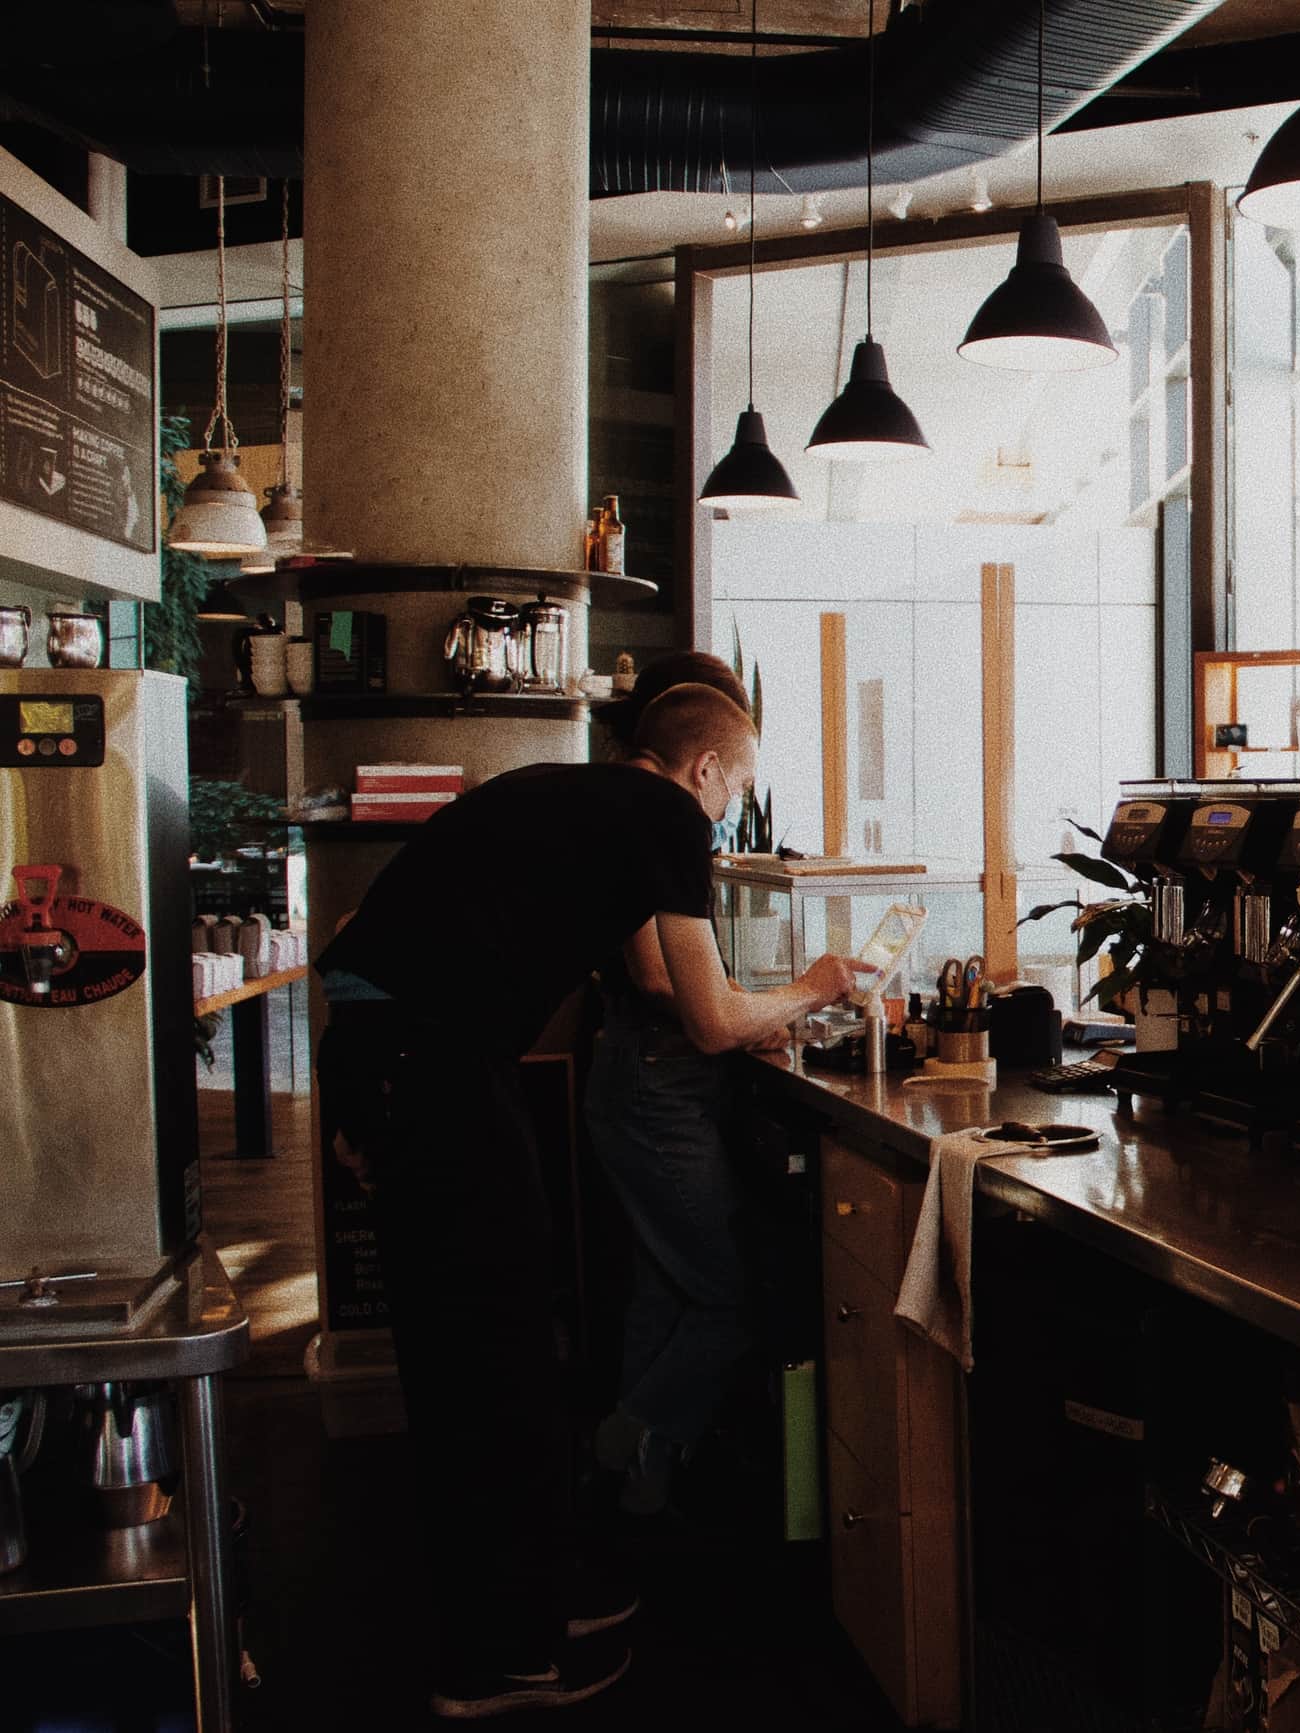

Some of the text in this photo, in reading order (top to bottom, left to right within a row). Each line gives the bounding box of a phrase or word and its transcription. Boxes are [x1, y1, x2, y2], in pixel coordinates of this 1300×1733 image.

[67, 899, 95, 915] HOT
[100, 907, 140, 939] WATER
[50, 988, 77, 1004] EAU
[82, 967, 135, 999] CHAUDE
